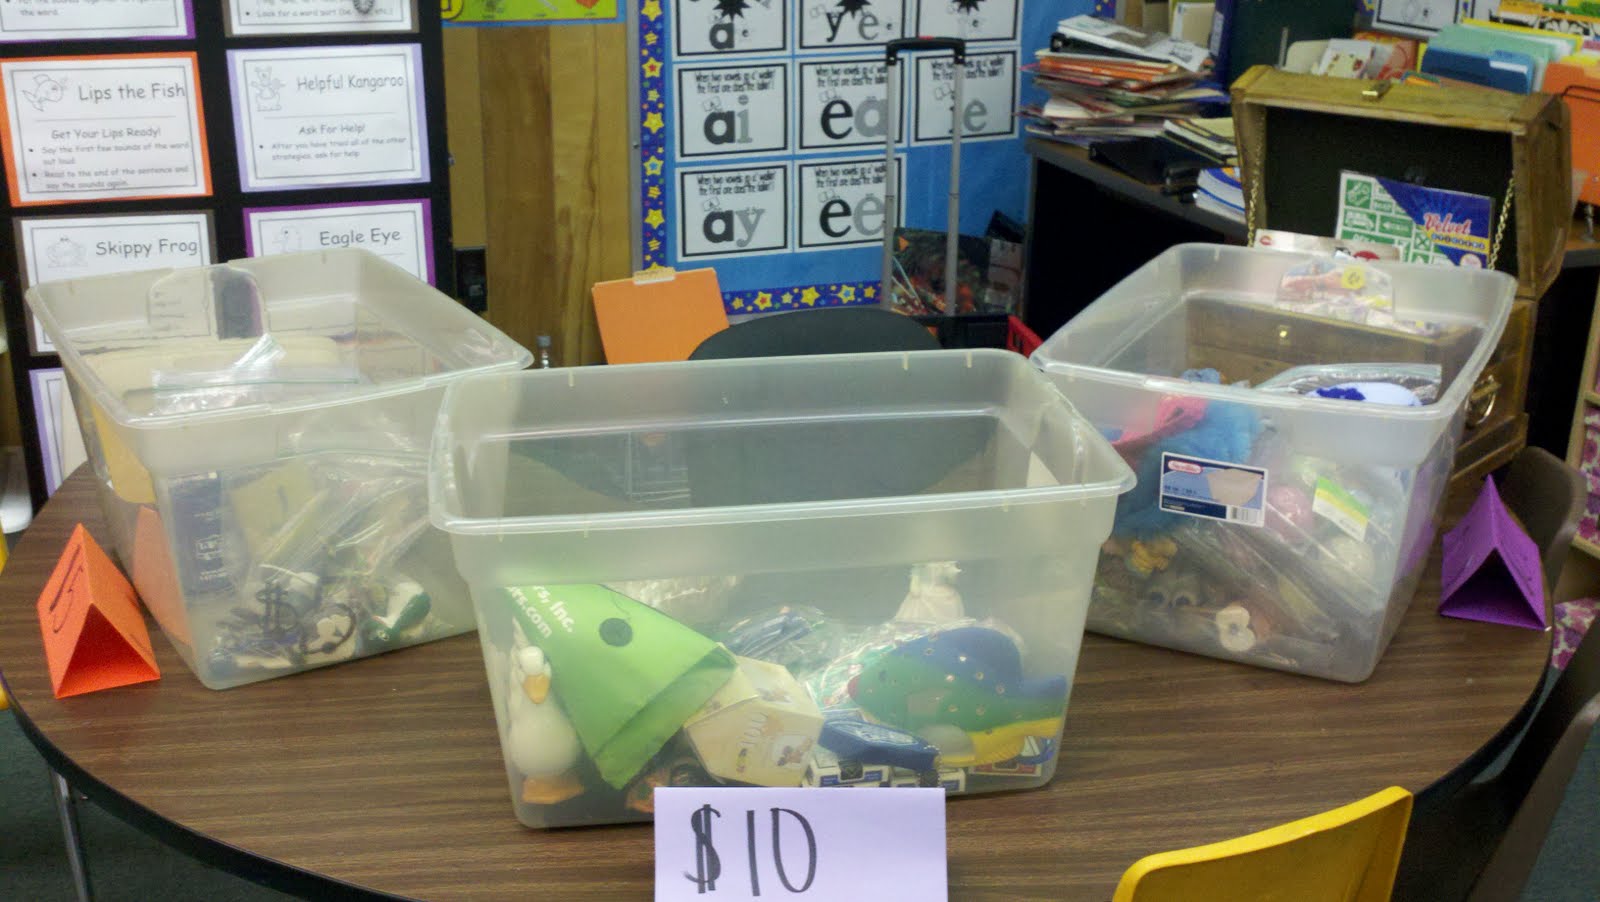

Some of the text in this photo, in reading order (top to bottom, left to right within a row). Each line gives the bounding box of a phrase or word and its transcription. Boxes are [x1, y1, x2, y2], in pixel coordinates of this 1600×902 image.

[709, 22, 734, 49] a
[79, 82, 186, 104] Lips the Fish
[298, 75, 405, 94] Helpful Kangaroo
[299, 123, 365, 135] Ask For Help!
[704, 96, 752, 144] ai
[51, 127, 161, 140] Get Your Lips Ready!
[59, 145, 73, 153] the
[76, 145, 94, 153] first
[97, 144, 111, 152] few
[114, 143, 141, 151] sounds
[155, 142, 168, 150] the
[170, 141, 190, 149] word
[703, 207, 765, 247] ay
[819, 197, 886, 238] ee
[1424, 212, 1472, 235] Velvet
[96, 239, 198, 258] Skippy Frog
[320, 228, 401, 248] Eagle Eye
[549, 600, 575, 633] Inc.
[684, 803, 817, 897] $10
